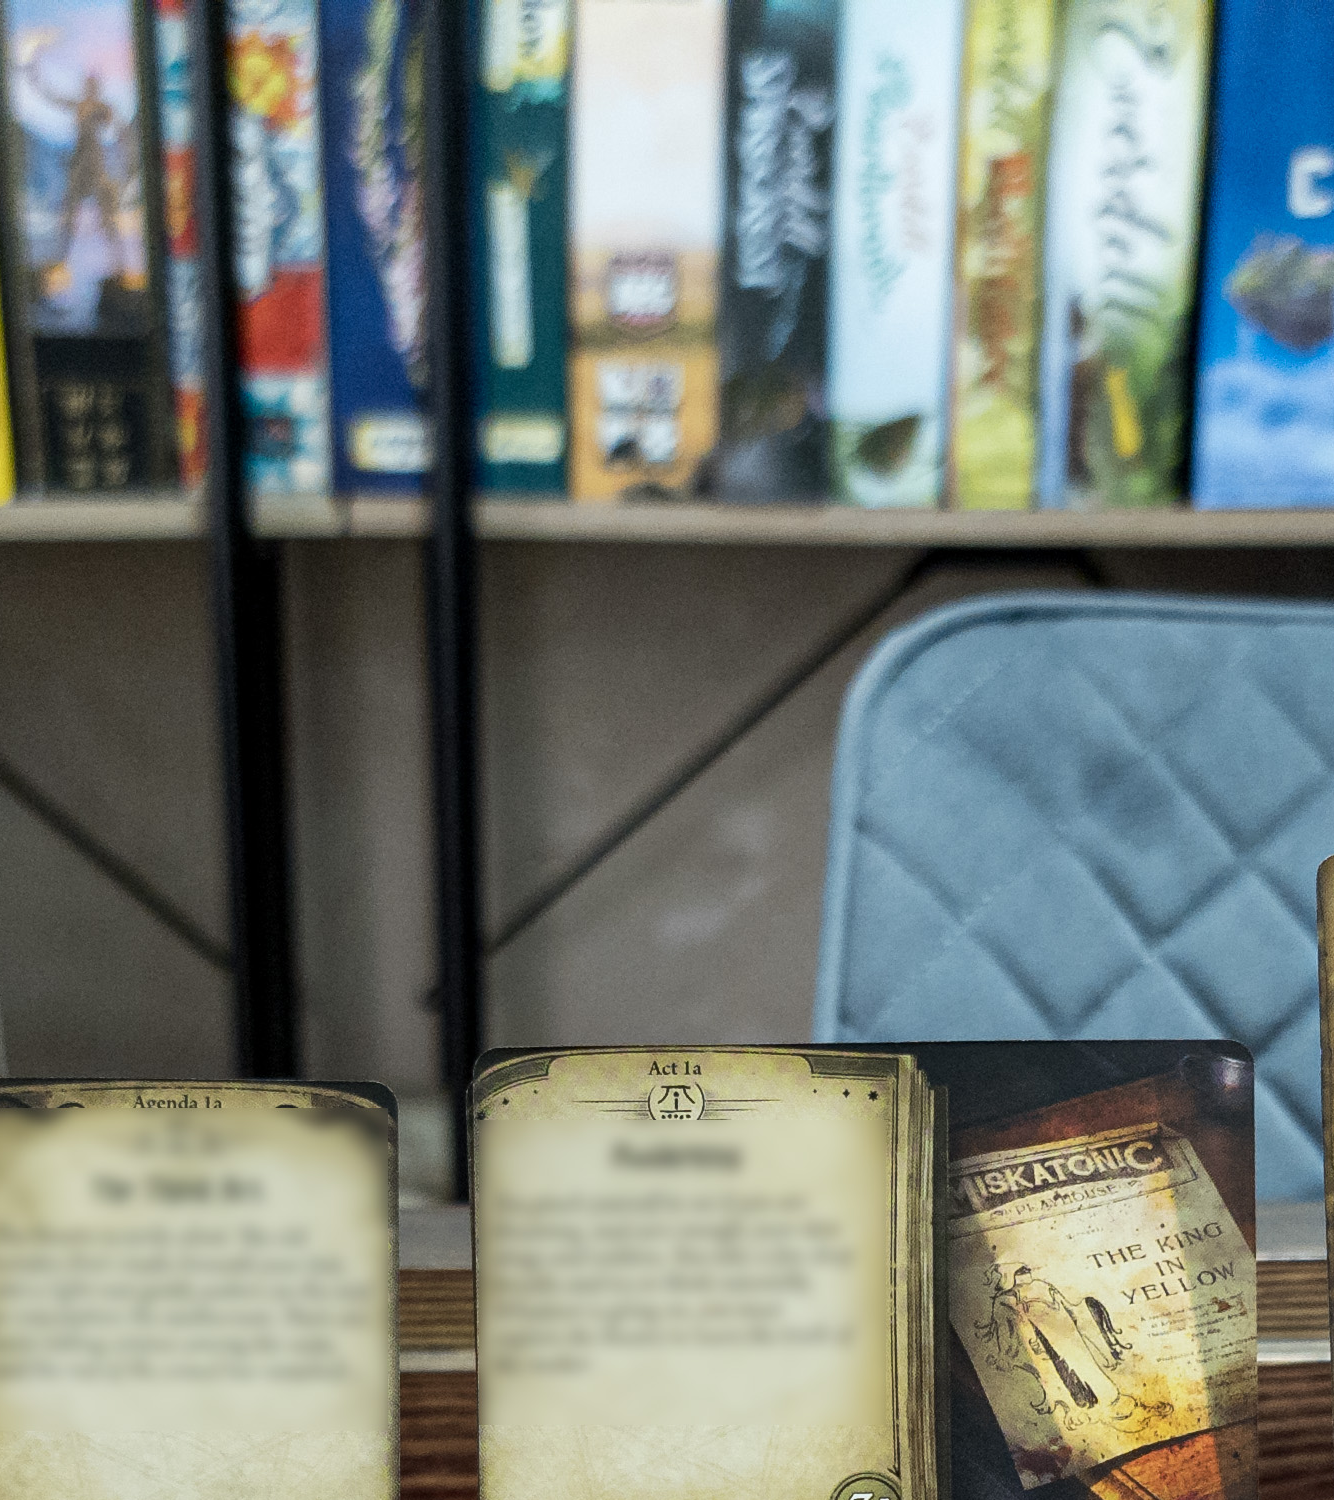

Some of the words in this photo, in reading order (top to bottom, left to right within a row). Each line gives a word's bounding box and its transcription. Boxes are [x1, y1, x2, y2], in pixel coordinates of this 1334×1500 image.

[648, 1060, 679, 1075] Act
[684, 1060, 702, 1075] 1a
[132, 1094, 198, 1110] Agenda
[1086, 1243, 1147, 1269] THE
[1156, 1221, 1223, 1254] KING
[1153, 1256, 1186, 1277] IN
[1120, 1261, 1236, 1305] YELLOW
